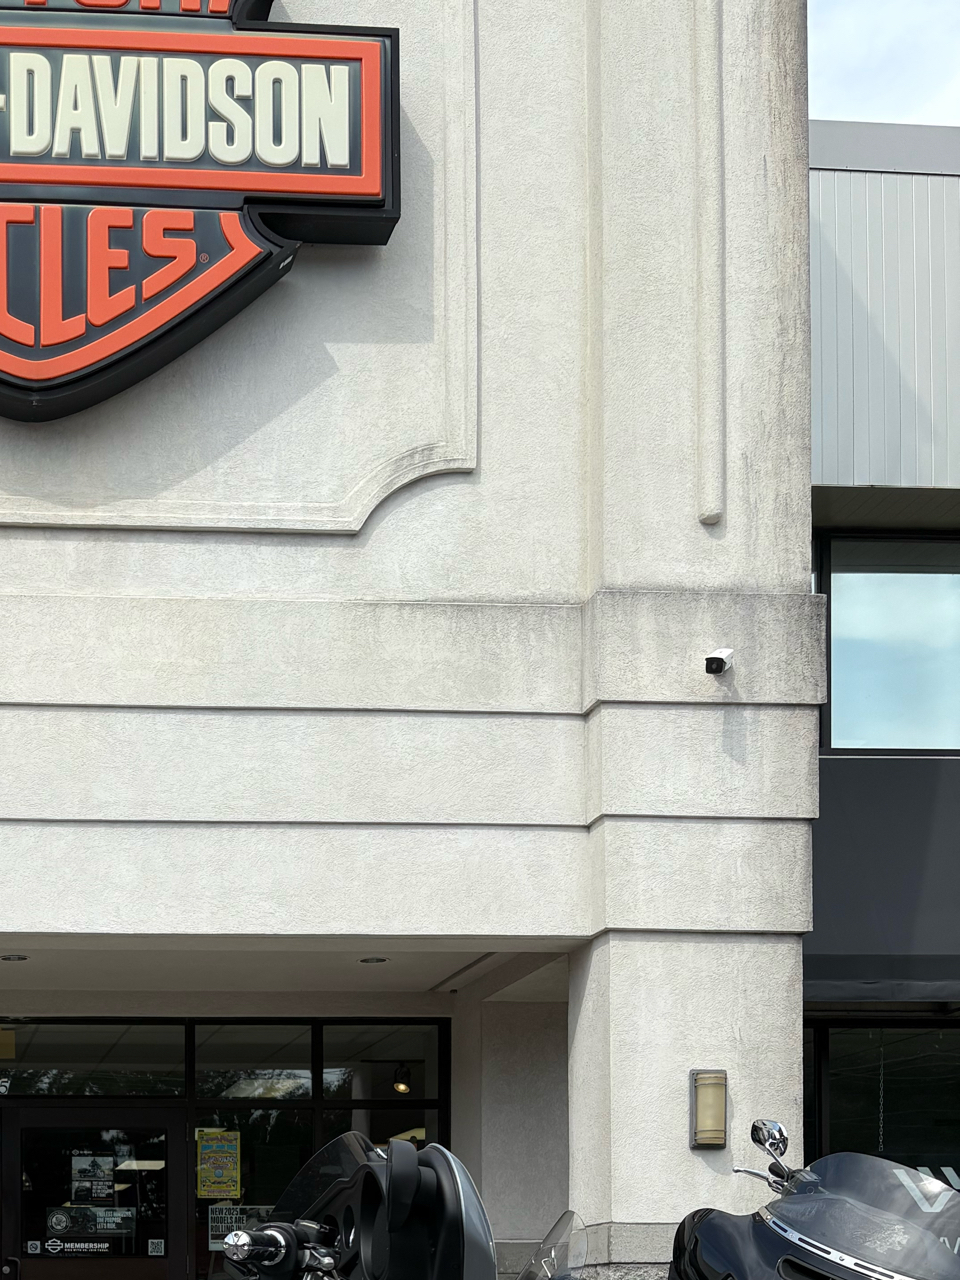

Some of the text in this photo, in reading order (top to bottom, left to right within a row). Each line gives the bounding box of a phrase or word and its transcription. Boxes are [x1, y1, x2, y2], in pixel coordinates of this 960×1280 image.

[210, 1207, 239, 1216] NEW 2025
[210, 1216, 245, 1225] MODELS ARE
[210, 1225, 234, 1233] ROLLING
